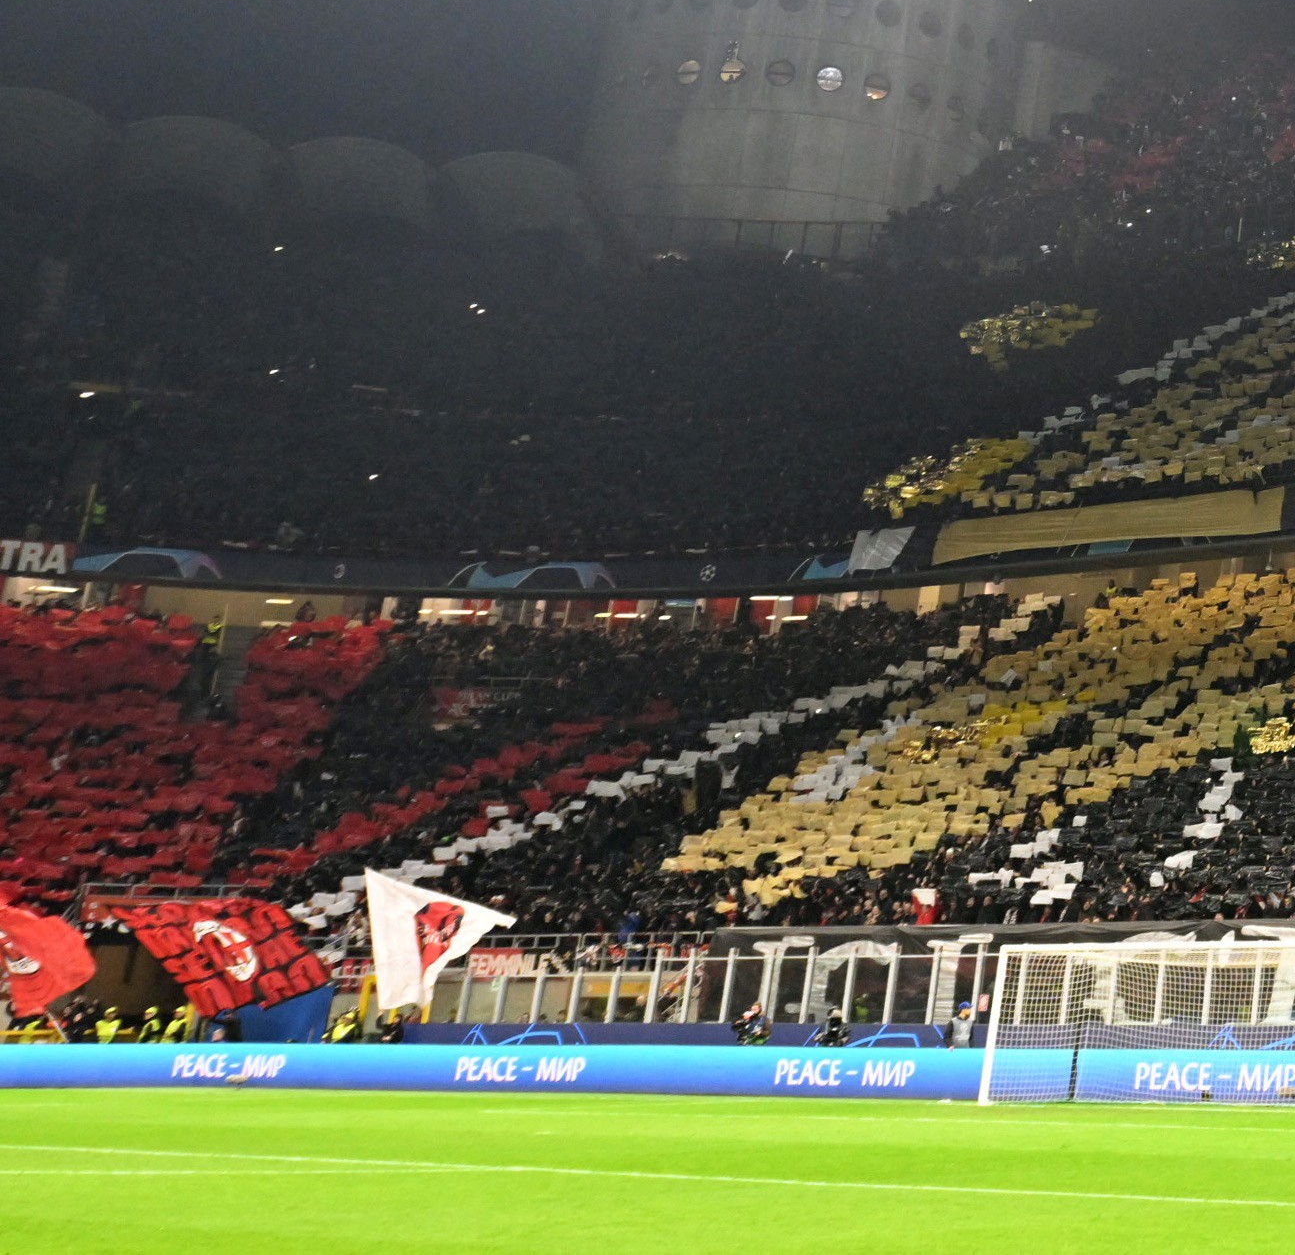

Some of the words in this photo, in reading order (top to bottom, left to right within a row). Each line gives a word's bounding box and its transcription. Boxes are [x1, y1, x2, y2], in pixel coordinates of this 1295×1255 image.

[171, 1054, 228, 1078] PEACE
[241, 1055, 286, 1078] МИР
[455, 1056, 519, 1082] PEACE
[536, 1057, 586, 1082] МИР
[775, 1059, 842, 1086] PEACE
[862, 1060, 915, 1087] МИР
[1134, 1062, 1212, 1090] PEACE
